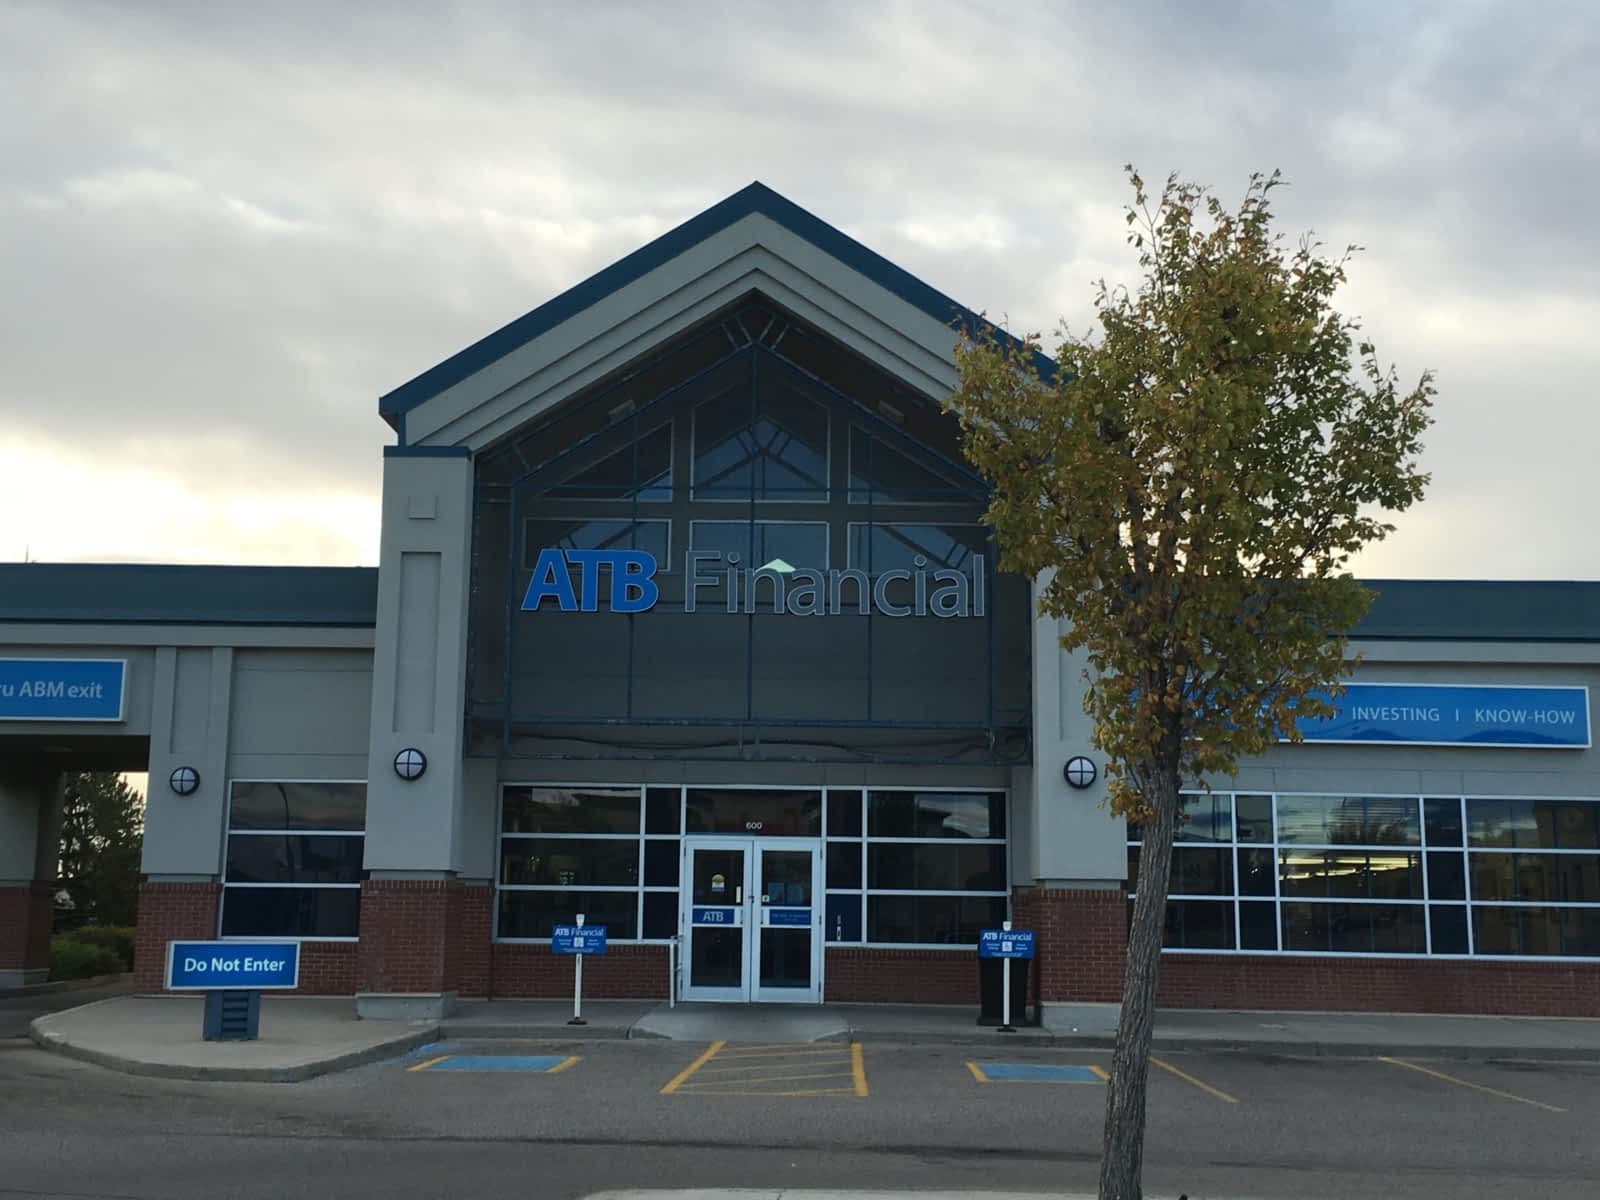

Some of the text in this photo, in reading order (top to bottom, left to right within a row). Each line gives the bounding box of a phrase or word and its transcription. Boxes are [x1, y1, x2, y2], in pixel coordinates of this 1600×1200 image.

[520, 548, 986, 618] ATB Financial
[19, 680, 64, 698] ABM
[67, 681, 104, 699] exit
[1351, 706, 1441, 723] INVESTING
[1475, 709, 1576, 725] KNOW-HOW
[745, 821, 763, 830] 600
[702, 911, 724, 923] ATB
[554, 927, 604, 937] ATB Financial
[982, 931, 1032, 941] ATB Financial
[184, 957, 286, 973] Do Not Enter
